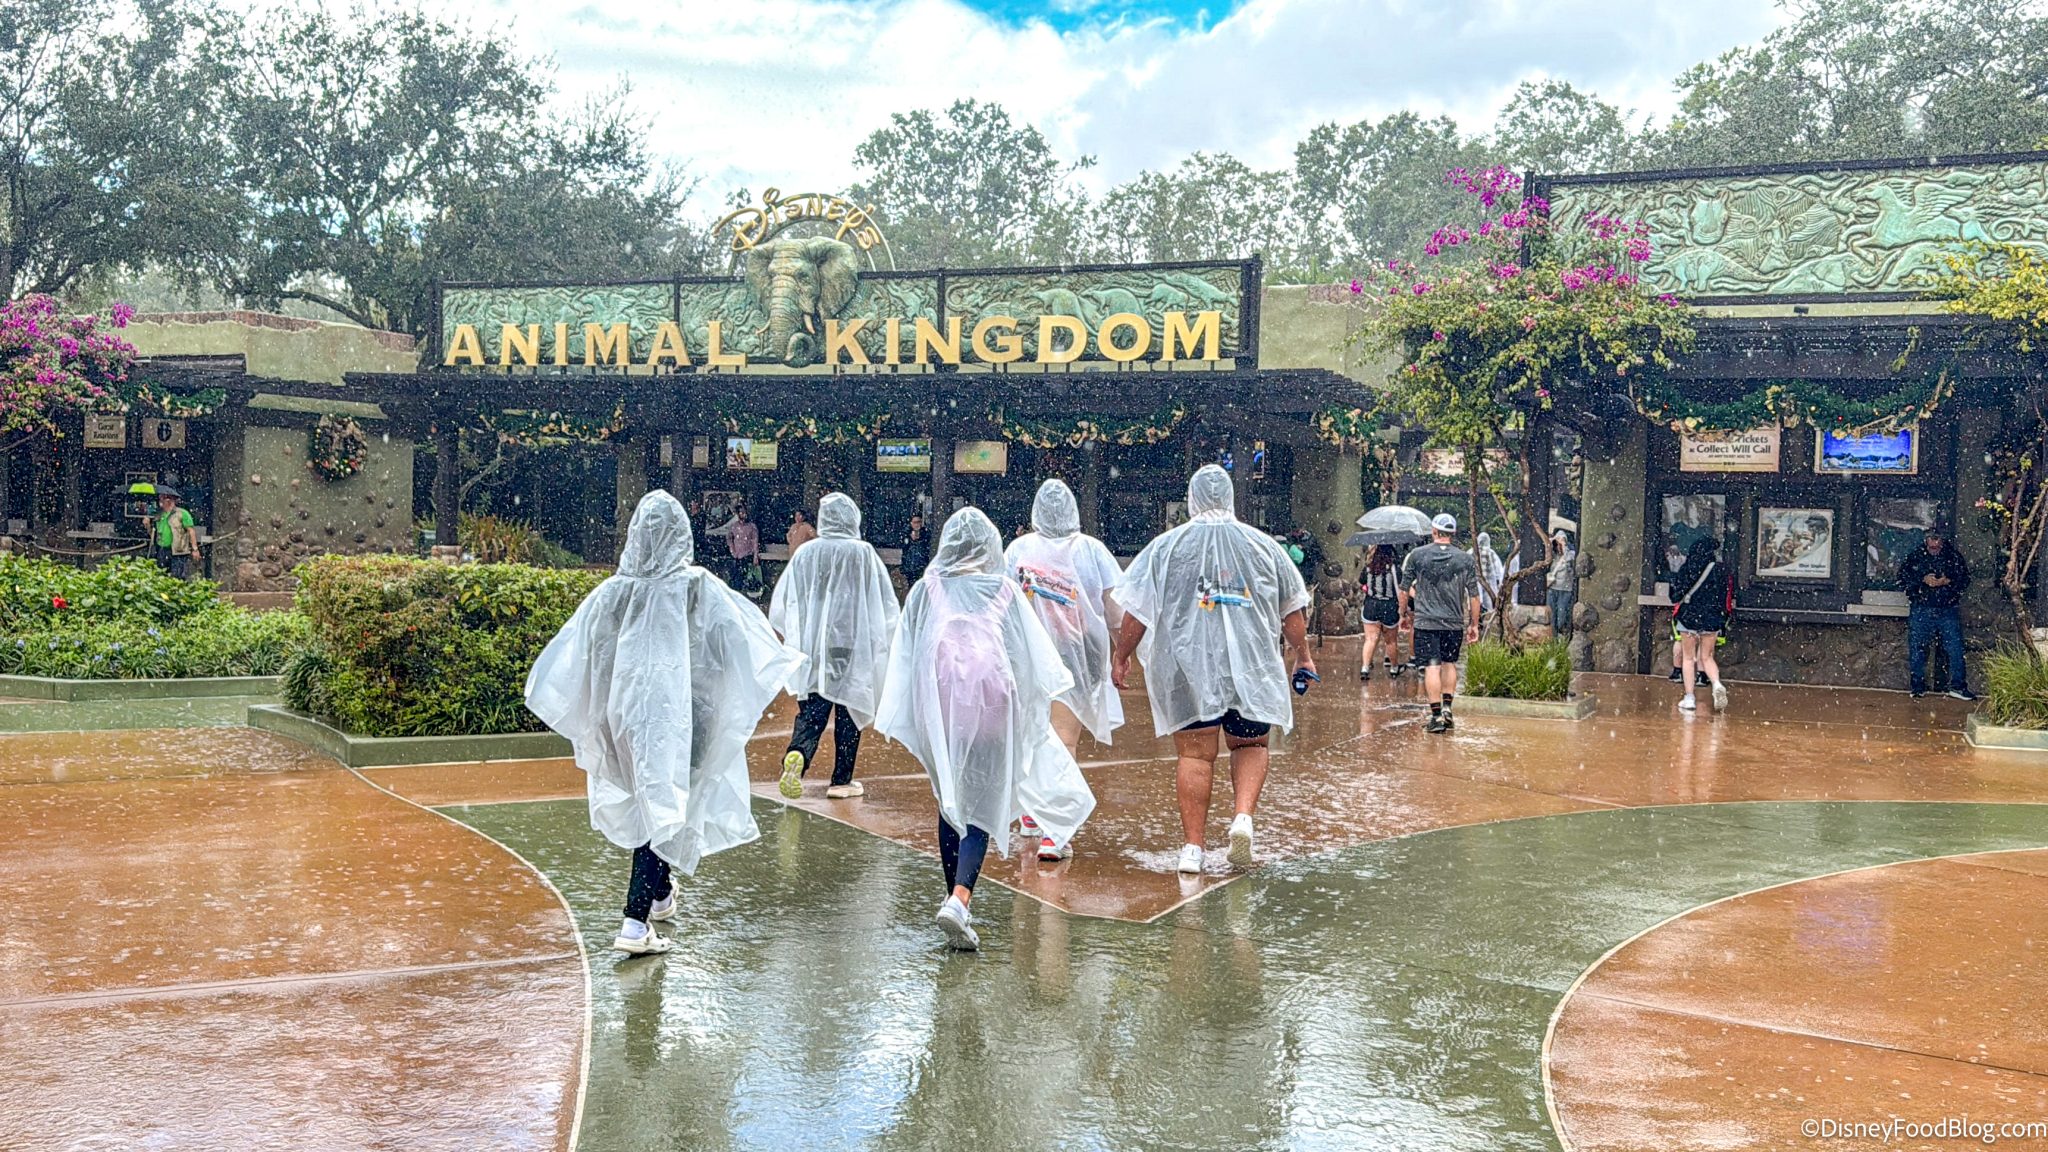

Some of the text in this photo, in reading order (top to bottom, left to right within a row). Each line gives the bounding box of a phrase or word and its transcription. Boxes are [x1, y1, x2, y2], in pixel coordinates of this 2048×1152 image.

[444, 310, 1222, 368] ANIMAL KINGDOM
[1696, 444, 1729, 454] Collect
[1731, 444, 1751, 454] Will
[1753, 444, 1771, 454] Call
